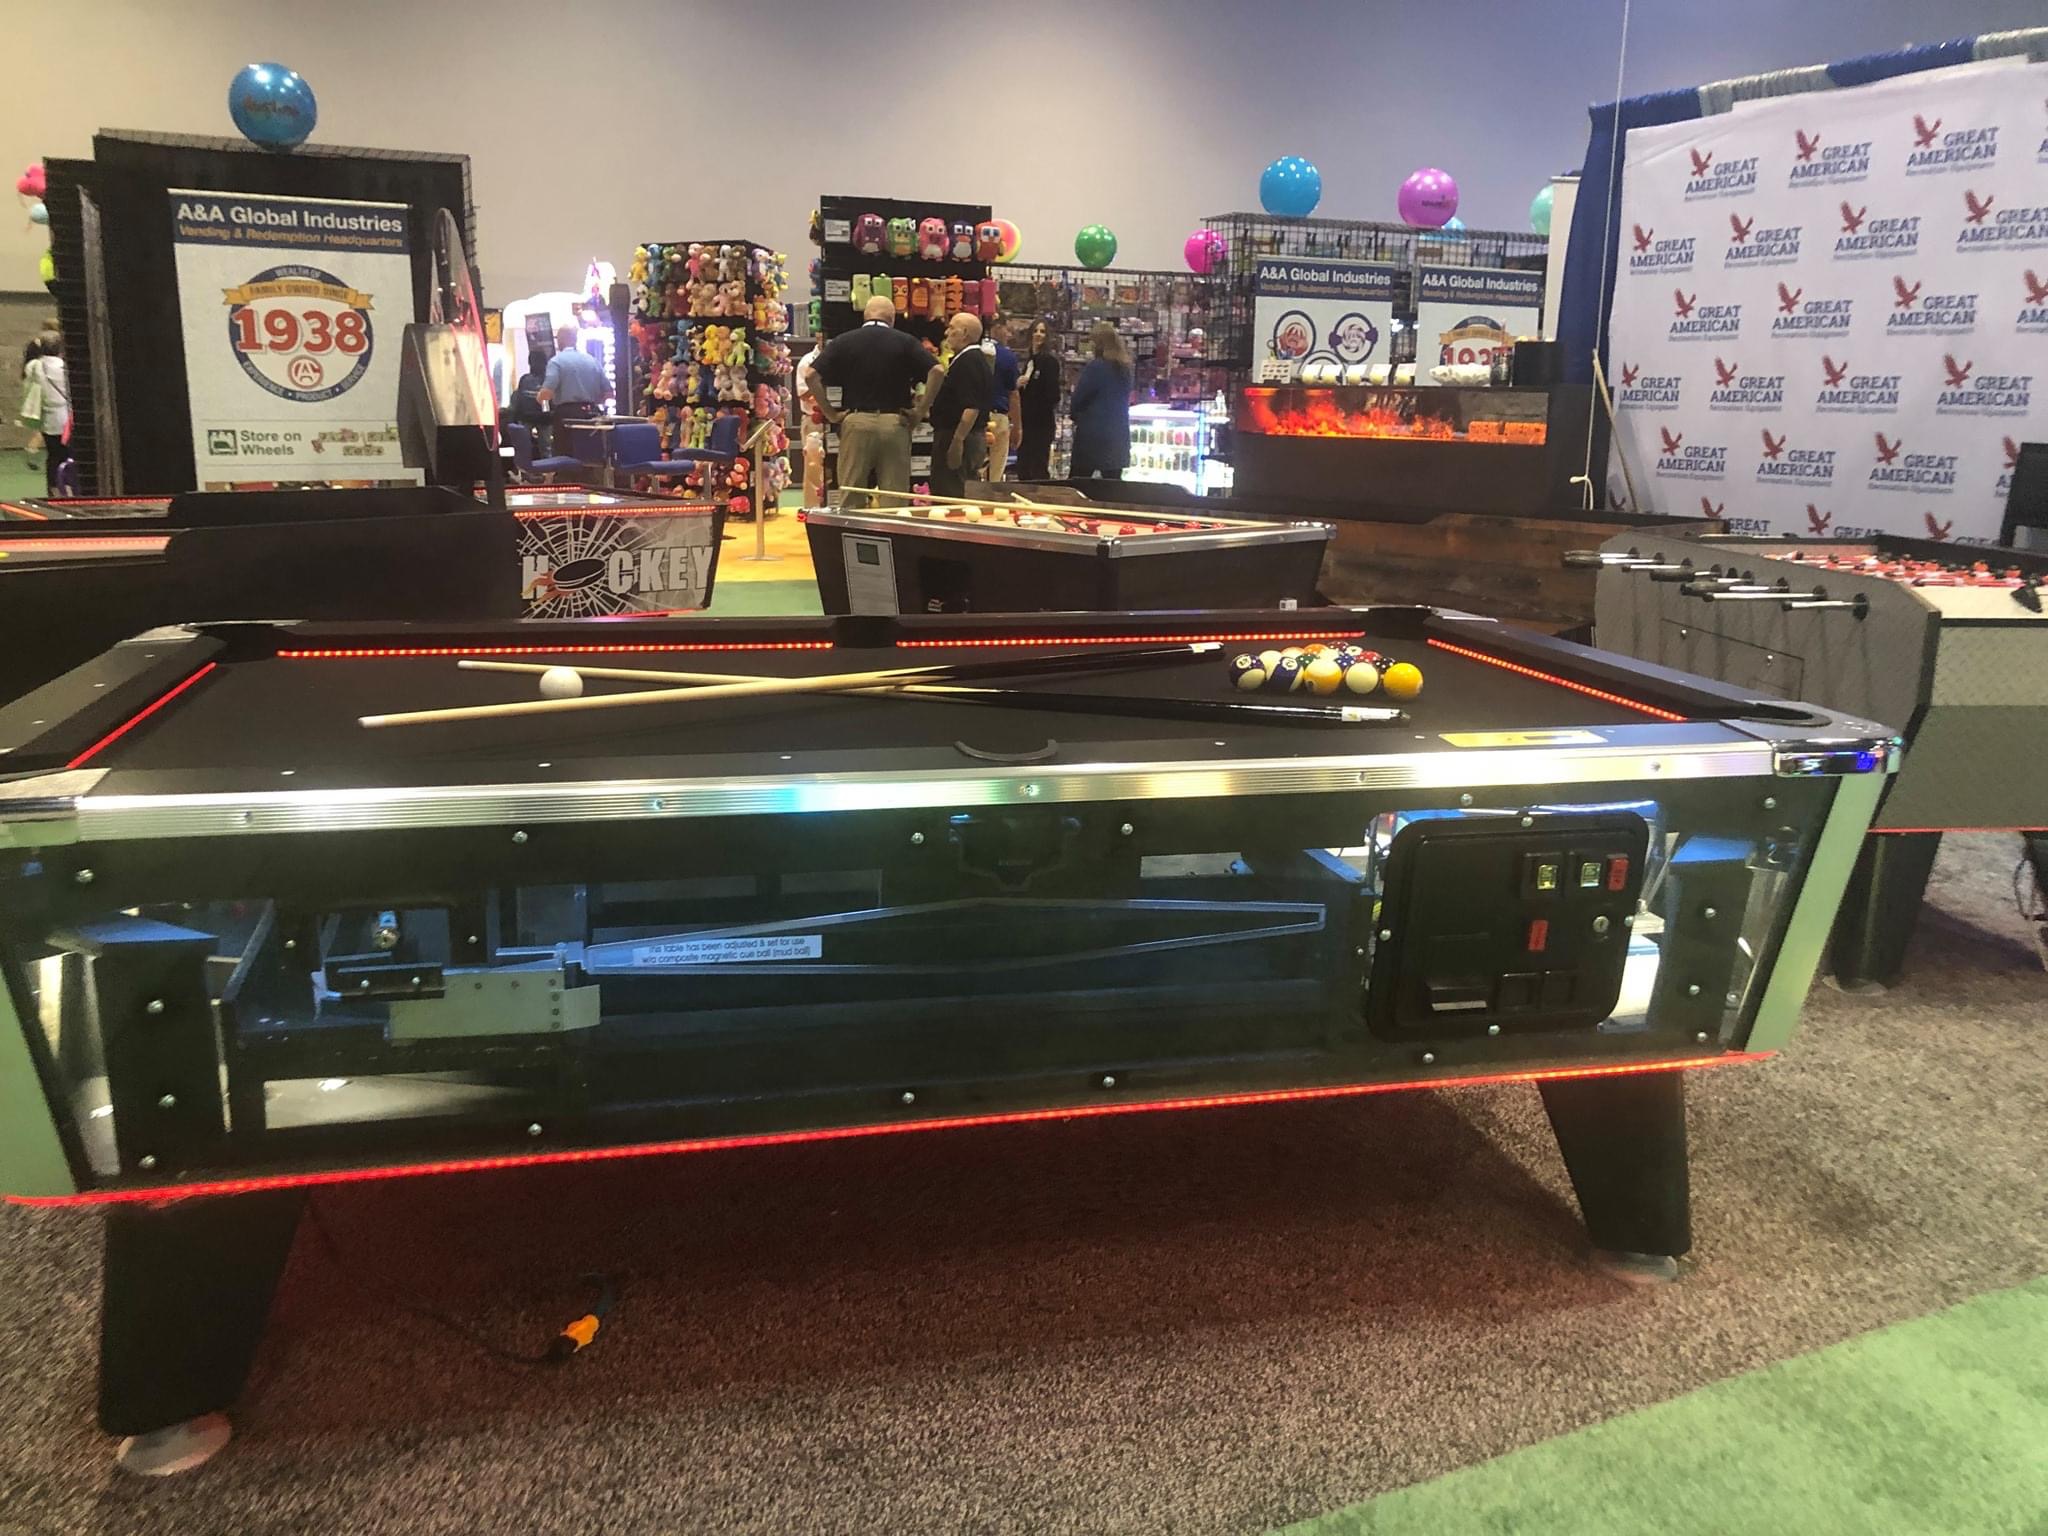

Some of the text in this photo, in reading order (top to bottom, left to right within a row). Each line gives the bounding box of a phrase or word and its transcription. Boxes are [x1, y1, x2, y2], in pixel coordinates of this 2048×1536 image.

[1944, 127, 1999, 147] GREAT
[1822, 142, 1872, 161] GREAT
[1906, 143, 1998, 166] AMERICAN
[1714, 157, 1759, 175] GREAT
[1790, 158, 1870, 180] AMERICAN
[1685, 172, 1757, 193] AMERICAN
[177, 203, 402, 232] A&A Global Industries
[1868, 216, 1921, 234] GREAT
[247, 229, 320, 244] Redemption
[323, 234, 402, 247] Headquarters
[1755, 227, 1802, 242] GREAT
[1834, 232, 1919, 251] AMERICAN
[1655, 237, 1696, 252] GREAT
[1725, 241, 1800, 260] AMERICAN
[1630, 250, 1695, 267] AMERICAN
[1260, 266, 1391, 286] A&A Global Industries
[1422, 274, 1538, 293] A&A Global Industries
[1803, 300, 1853, 314] GREAT
[1923, 294, 1978, 310] GREAT
[1698, 305, 1741, 319] GREAT
[1887, 310, 1977, 326] AMERICAN
[232, 308, 368, 353] 1938
[1670, 319, 1740, 333] AMERICAN
[1772, 315, 1850, 330] AMERICAN
[1641, 377, 1682, 389] GREAT
[1739, 376, 1785, 389] GREAT
[1850, 376, 1901, 389] GREAT
[1974, 376, 2033, 391] GREAT
[1620, 390, 1679, 402] MERICAN
[1709, 390, 1783, 403] AMERICAN
[1816, 390, 1899, 404] AMERICAN
[1936, 391, 2031, 407] AMERICAN
[240, 430, 302, 442] Store on
[241, 444, 294, 456] Wheels
[1684, 446, 1728, 459] GREAT
[1788, 450, 1836, 464] GREAT
[1656, 459, 1725, 473] AMERICAN
[1904, 454, 1958, 470] GREAT
[1756, 463, 1834, 479] AMERICAN
[1869, 468, 1956, 485] AMERICAN
[702, 941, 722, 951] been
[724, 939, 757, 951] adjusted
[658, 952, 699, 964] composite
[701, 951, 738, 963] magnetic
[740, 951, 755, 959] cue
[757, 949, 772, 958] ball
